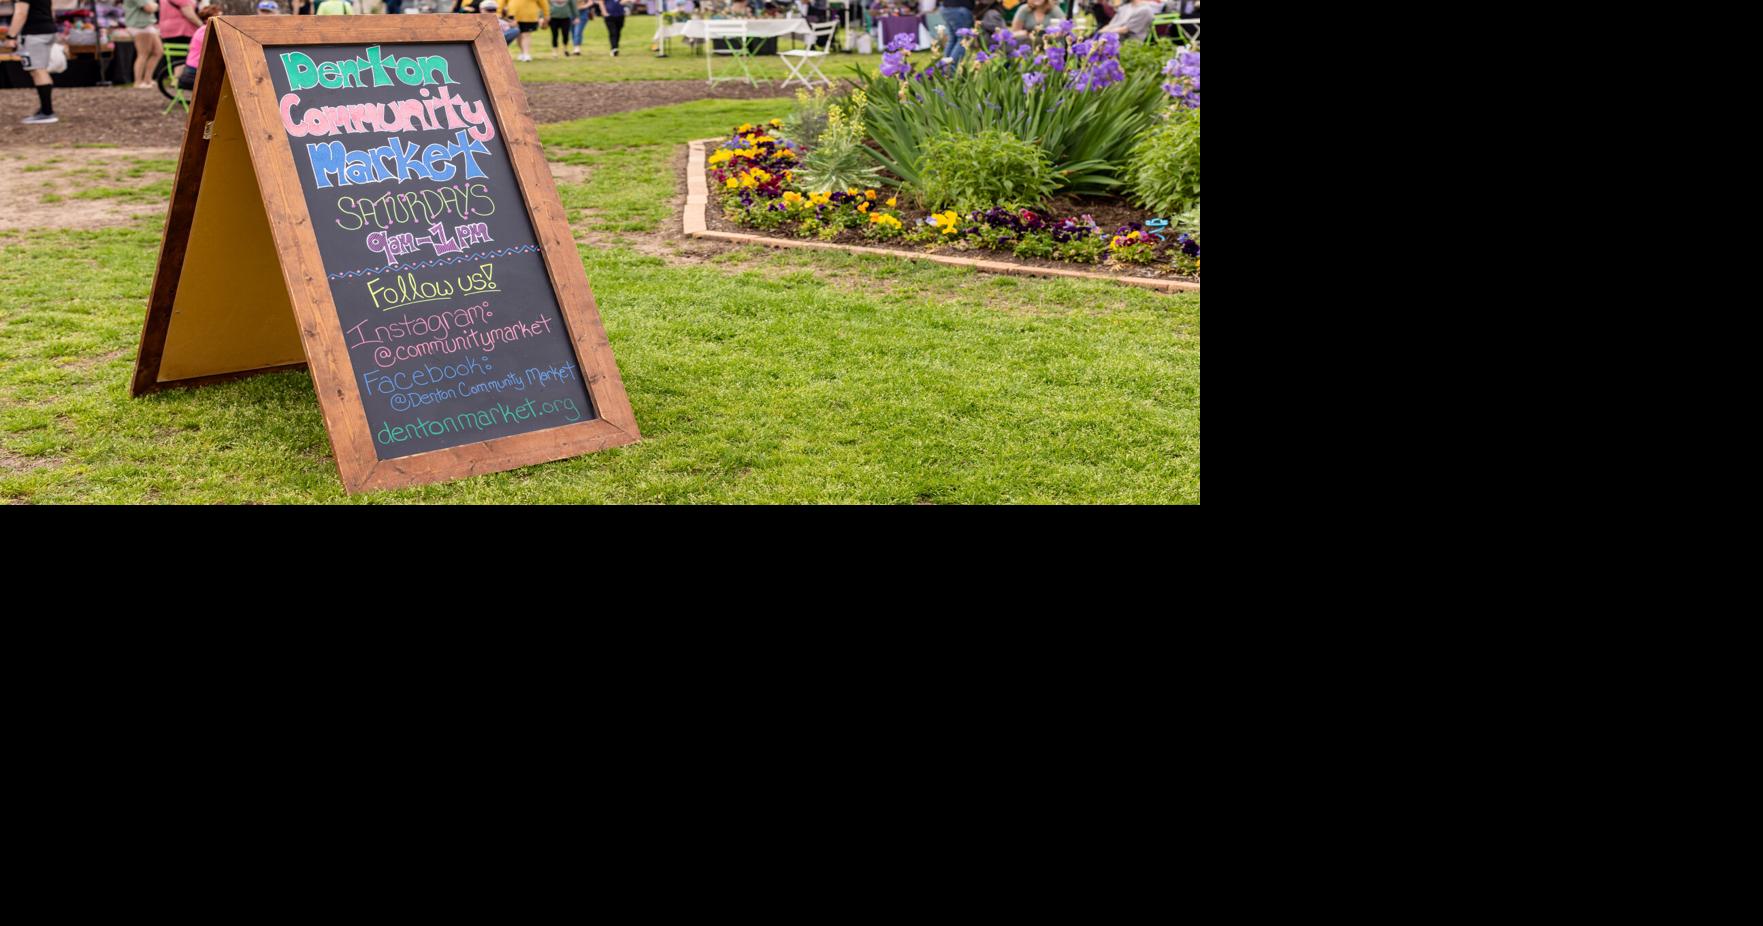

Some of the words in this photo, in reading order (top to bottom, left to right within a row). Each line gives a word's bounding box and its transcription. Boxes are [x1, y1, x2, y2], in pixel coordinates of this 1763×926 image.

[280, 45, 460, 91] Denton
[280, 86, 495, 142] Community
[306, 131, 492, 189] Market
[335, 183, 495, 230] SATURDAYS
[367, 273, 454, 309] Follow
[457, 263, 497, 292] us!
[347, 302, 493, 348] Instagram:
[374, 314, 552, 368] @communitymarket
[363, 356, 493, 396] Facebook:
[390, 387, 456, 412] @Denton
[458, 372, 525, 398] Community
[525, 360, 576, 388] Market
[377, 397, 581, 446] dentonmarket.org
